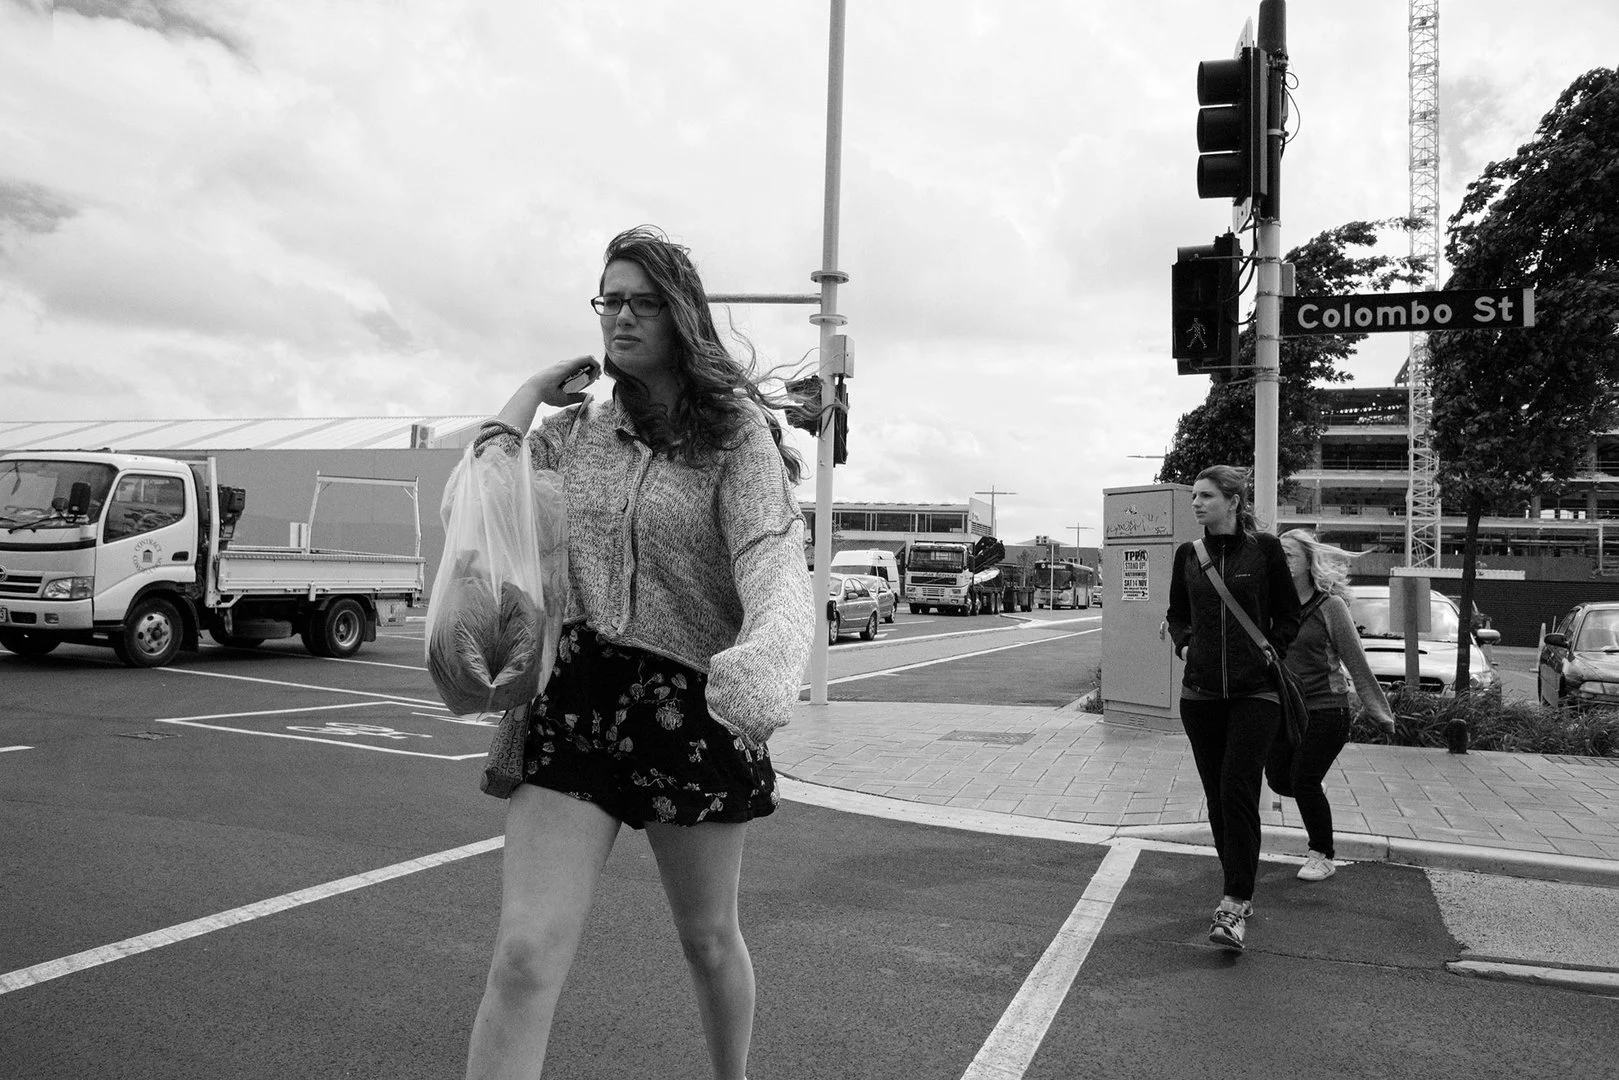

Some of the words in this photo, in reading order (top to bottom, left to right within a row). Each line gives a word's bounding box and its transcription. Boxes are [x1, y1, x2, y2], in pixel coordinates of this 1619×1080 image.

[1297, 300, 1453, 329] Colombo
[1473, 295, 1514, 323] St
[134, 539, 162, 553] CONTRACT
[1124, 551, 1146, 561] TPPA
